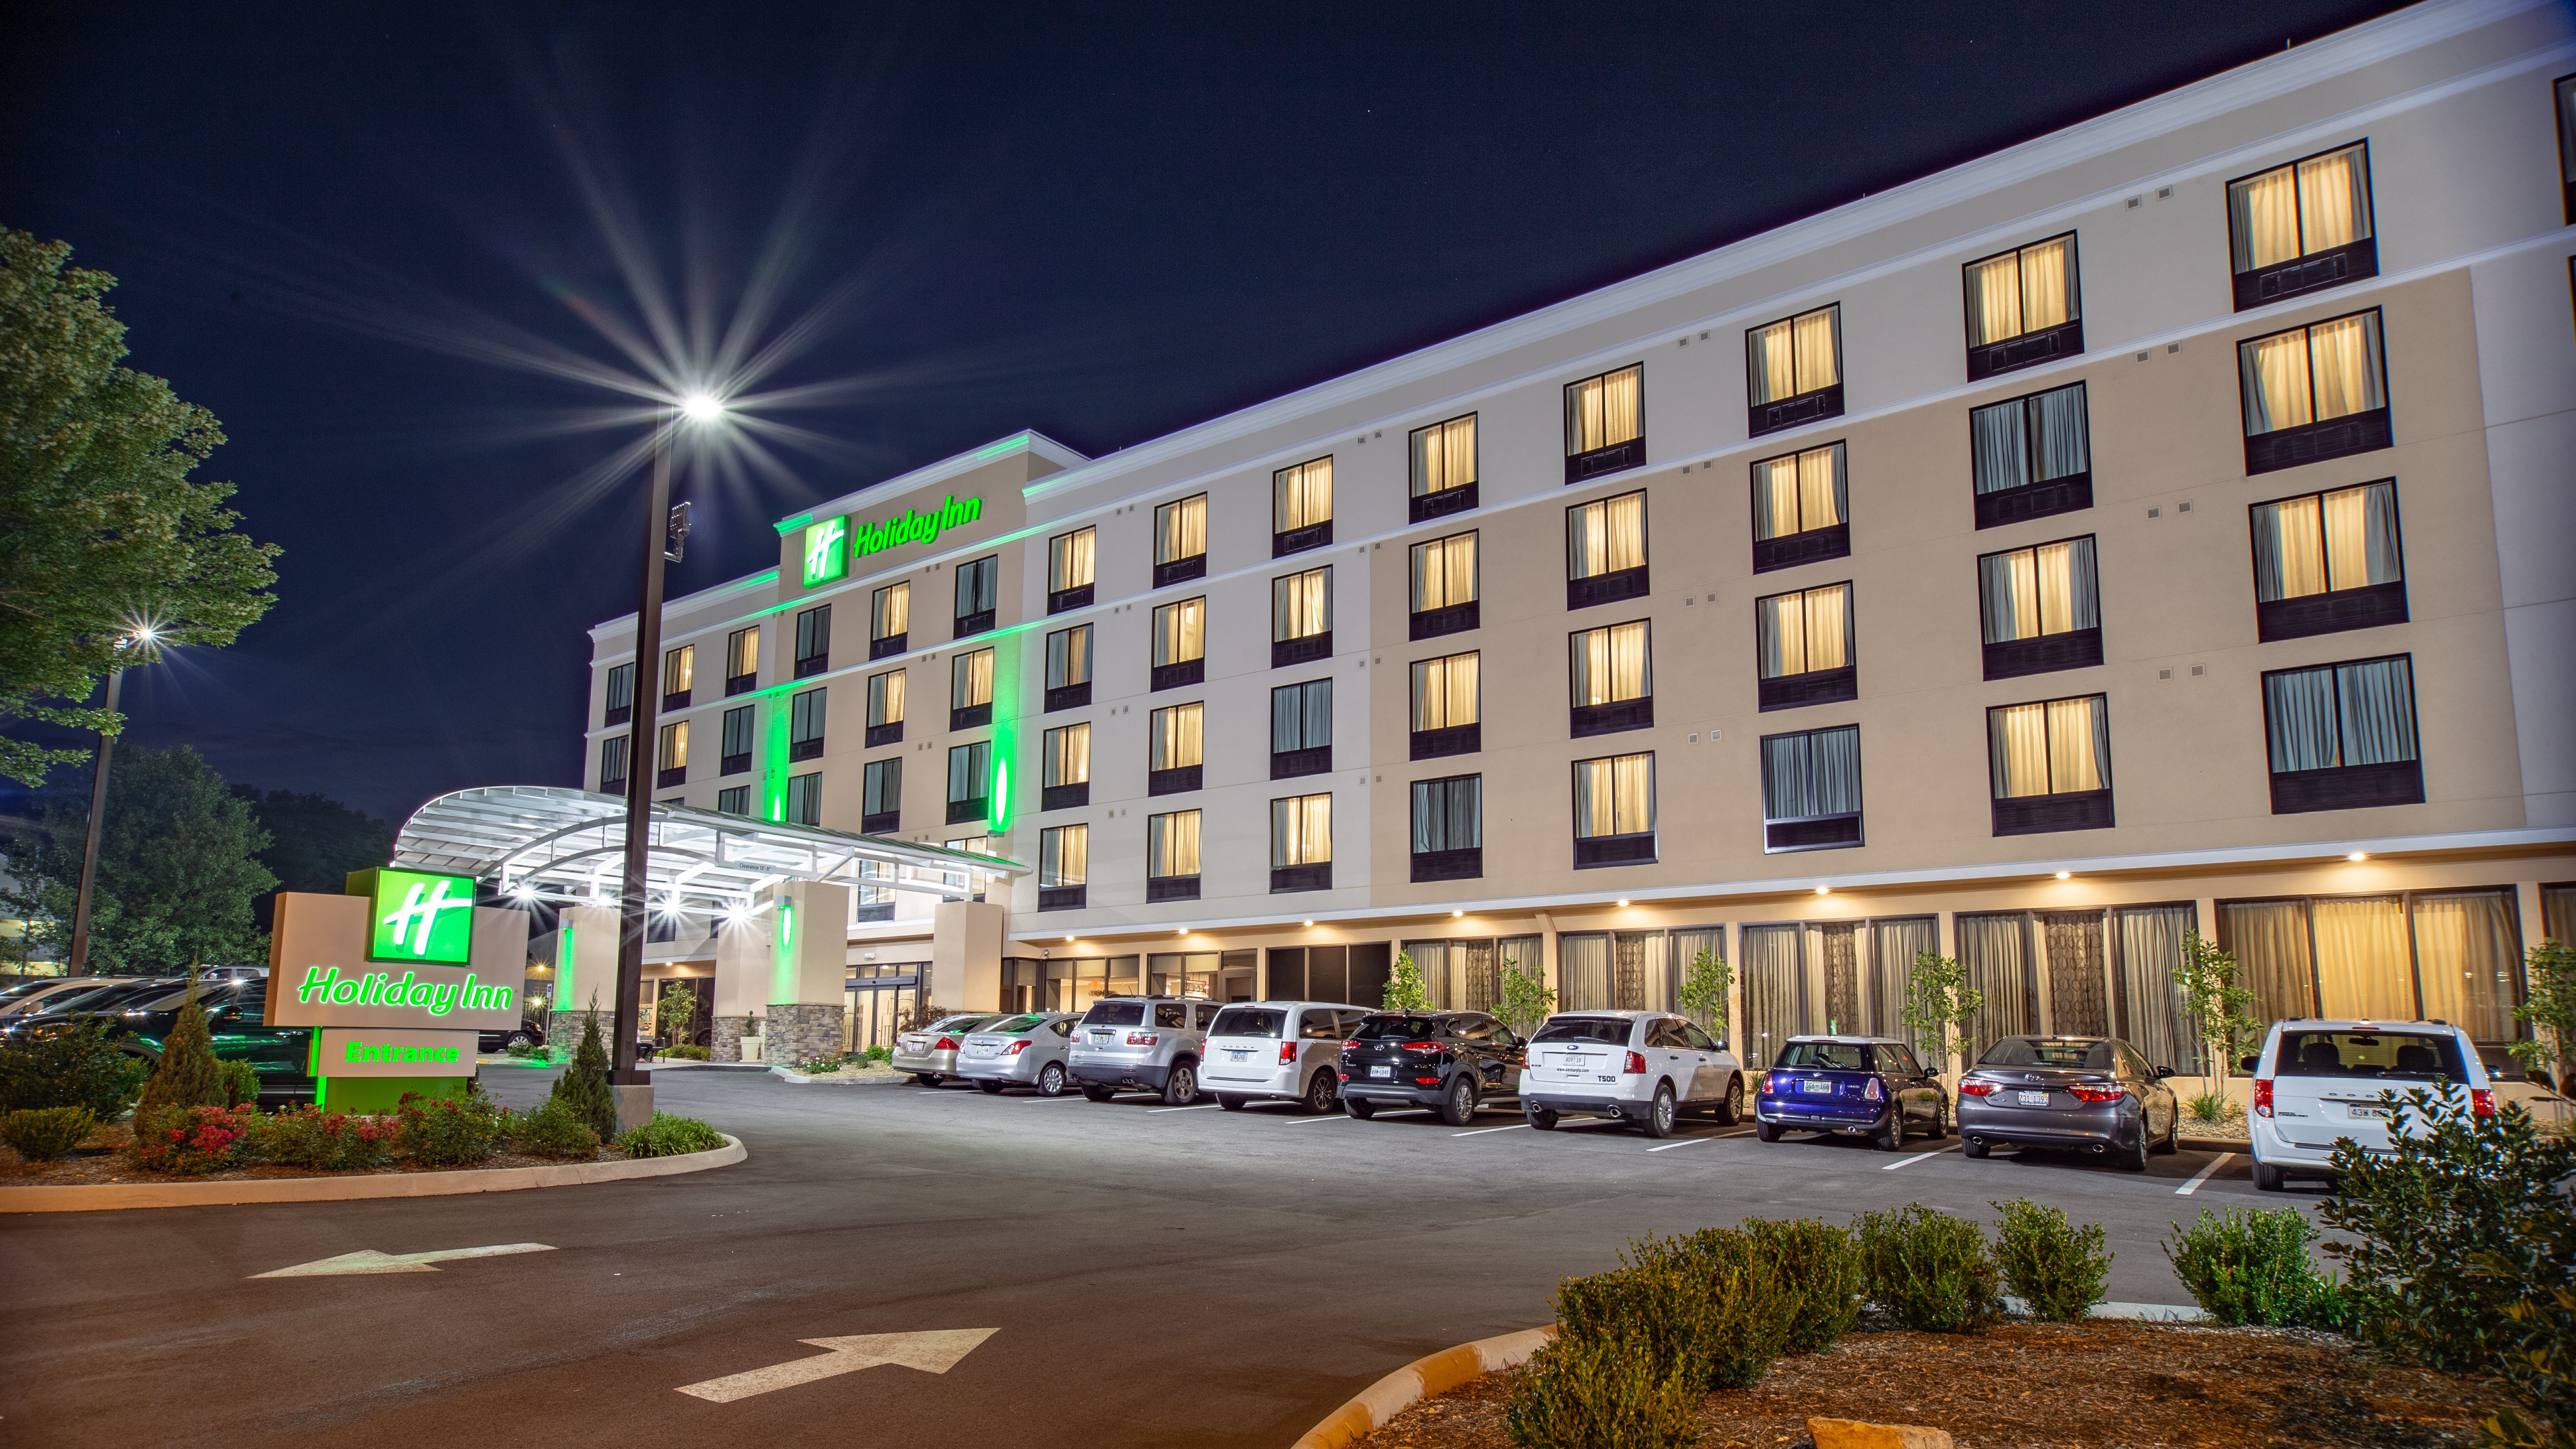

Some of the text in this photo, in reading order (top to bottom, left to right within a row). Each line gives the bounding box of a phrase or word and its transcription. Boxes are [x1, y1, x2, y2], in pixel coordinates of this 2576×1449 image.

[853, 495, 982, 558] Holiday Inn
[298, 966, 513, 1016] Holiday Inn
[345, 1041, 460, 1062] Entrance
